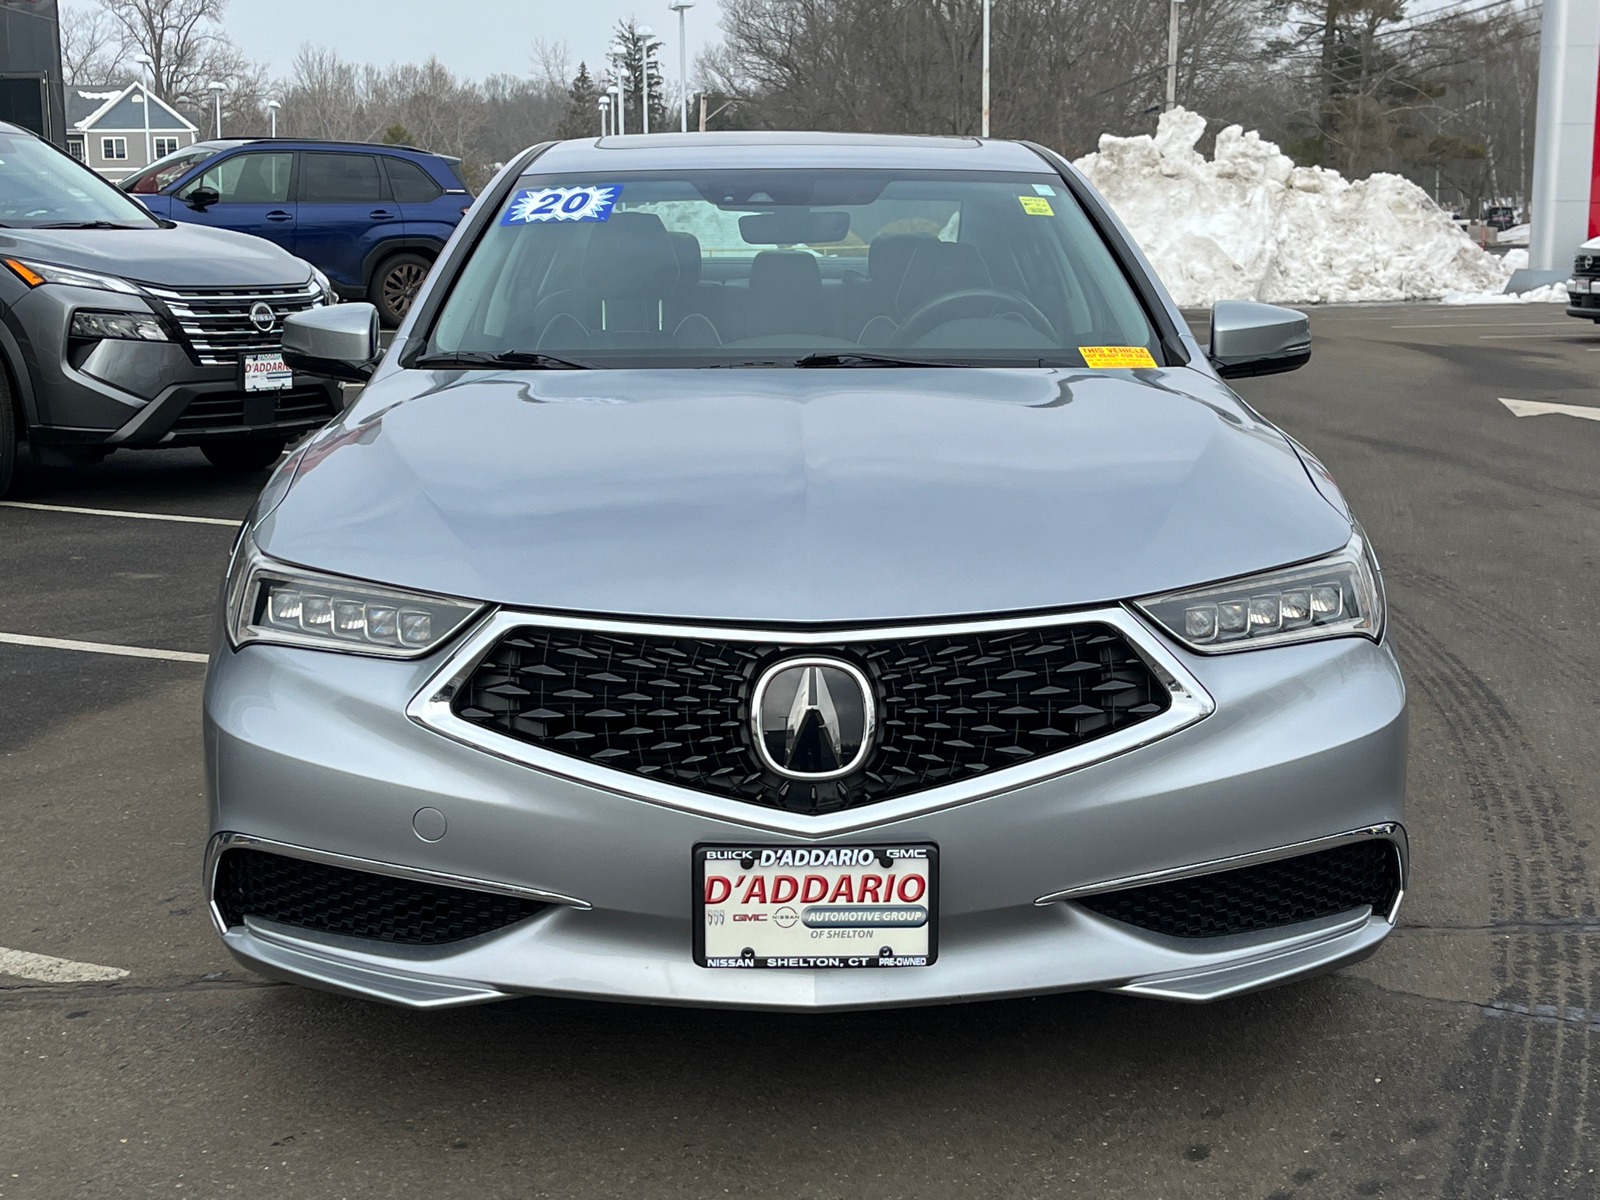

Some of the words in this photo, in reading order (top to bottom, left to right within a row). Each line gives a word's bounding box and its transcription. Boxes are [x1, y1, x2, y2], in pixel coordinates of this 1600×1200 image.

[528, 192, 591, 215] 20
[706, 850, 753, 860] BUICK
[760, 849, 875, 867] D'ADDARIO
[887, 849, 927, 858] GMC
[704, 874, 926, 905] D'ADDARIO
[732, 913, 768, 922] GMC
[808, 911, 881, 922] AUTOMOTIVE
[882, 911, 922, 921] GROUP
[810, 930, 825, 939] OF
[826, 930, 874, 939] SHELTON
[707, 959, 755, 968] NISSAN
[766, 958, 844, 968] SHELTON,
[847, 957, 869, 966] CT
[878, 957, 927, 967] PRE-OWNED
